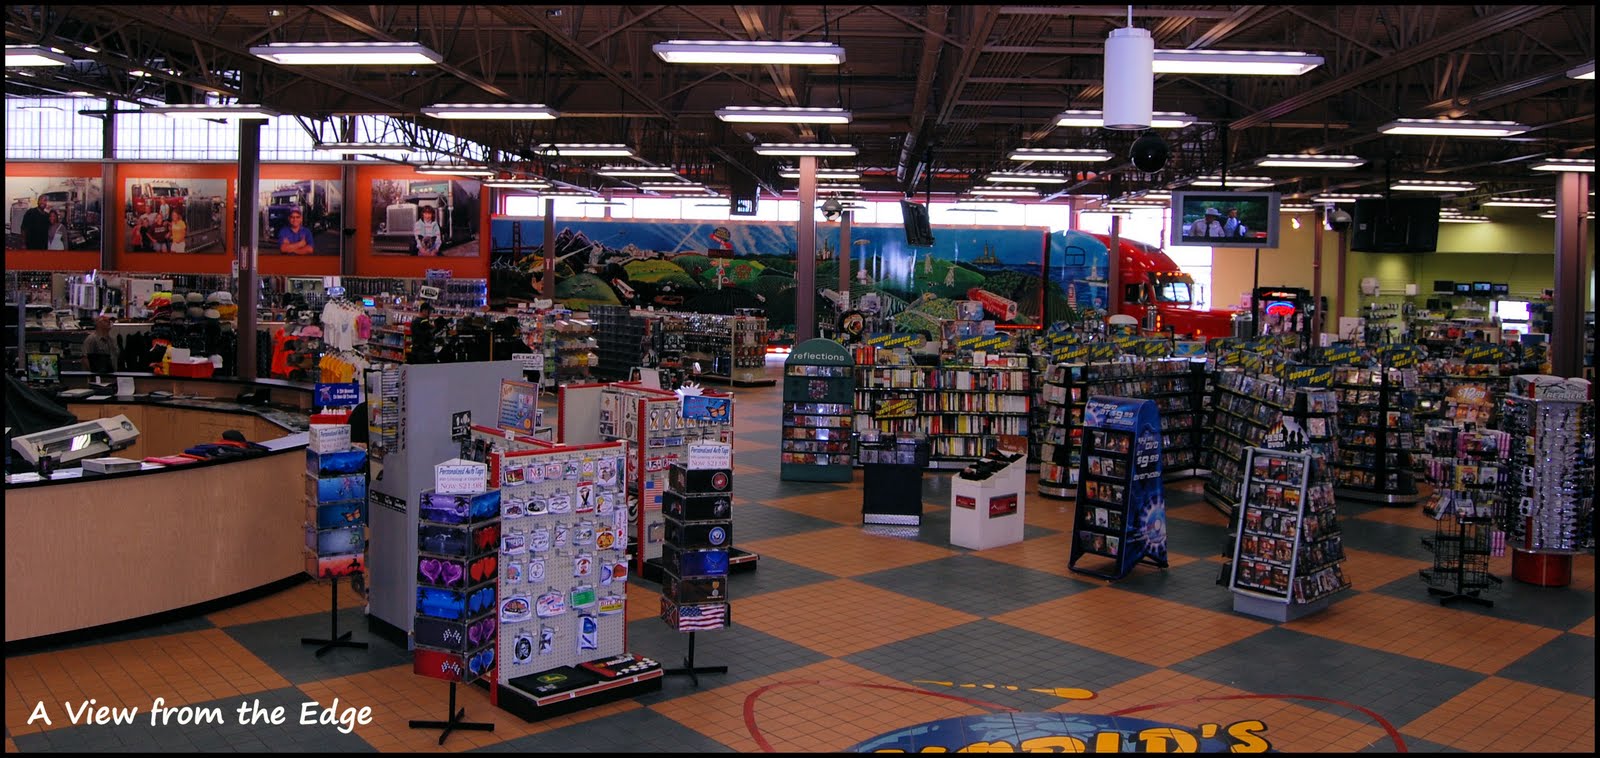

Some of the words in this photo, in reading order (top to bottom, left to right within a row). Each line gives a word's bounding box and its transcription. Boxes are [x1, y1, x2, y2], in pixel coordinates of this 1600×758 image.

[793, 352, 845, 362] reflections
[1289, 368, 1316, 380] BUDGET
[1109, 410, 1134, 420] $9.99
[1145, 441, 1159, 450] DVD
[1136, 453, 1160, 468] $9.99
[439, 467, 465, 475] Personalized
